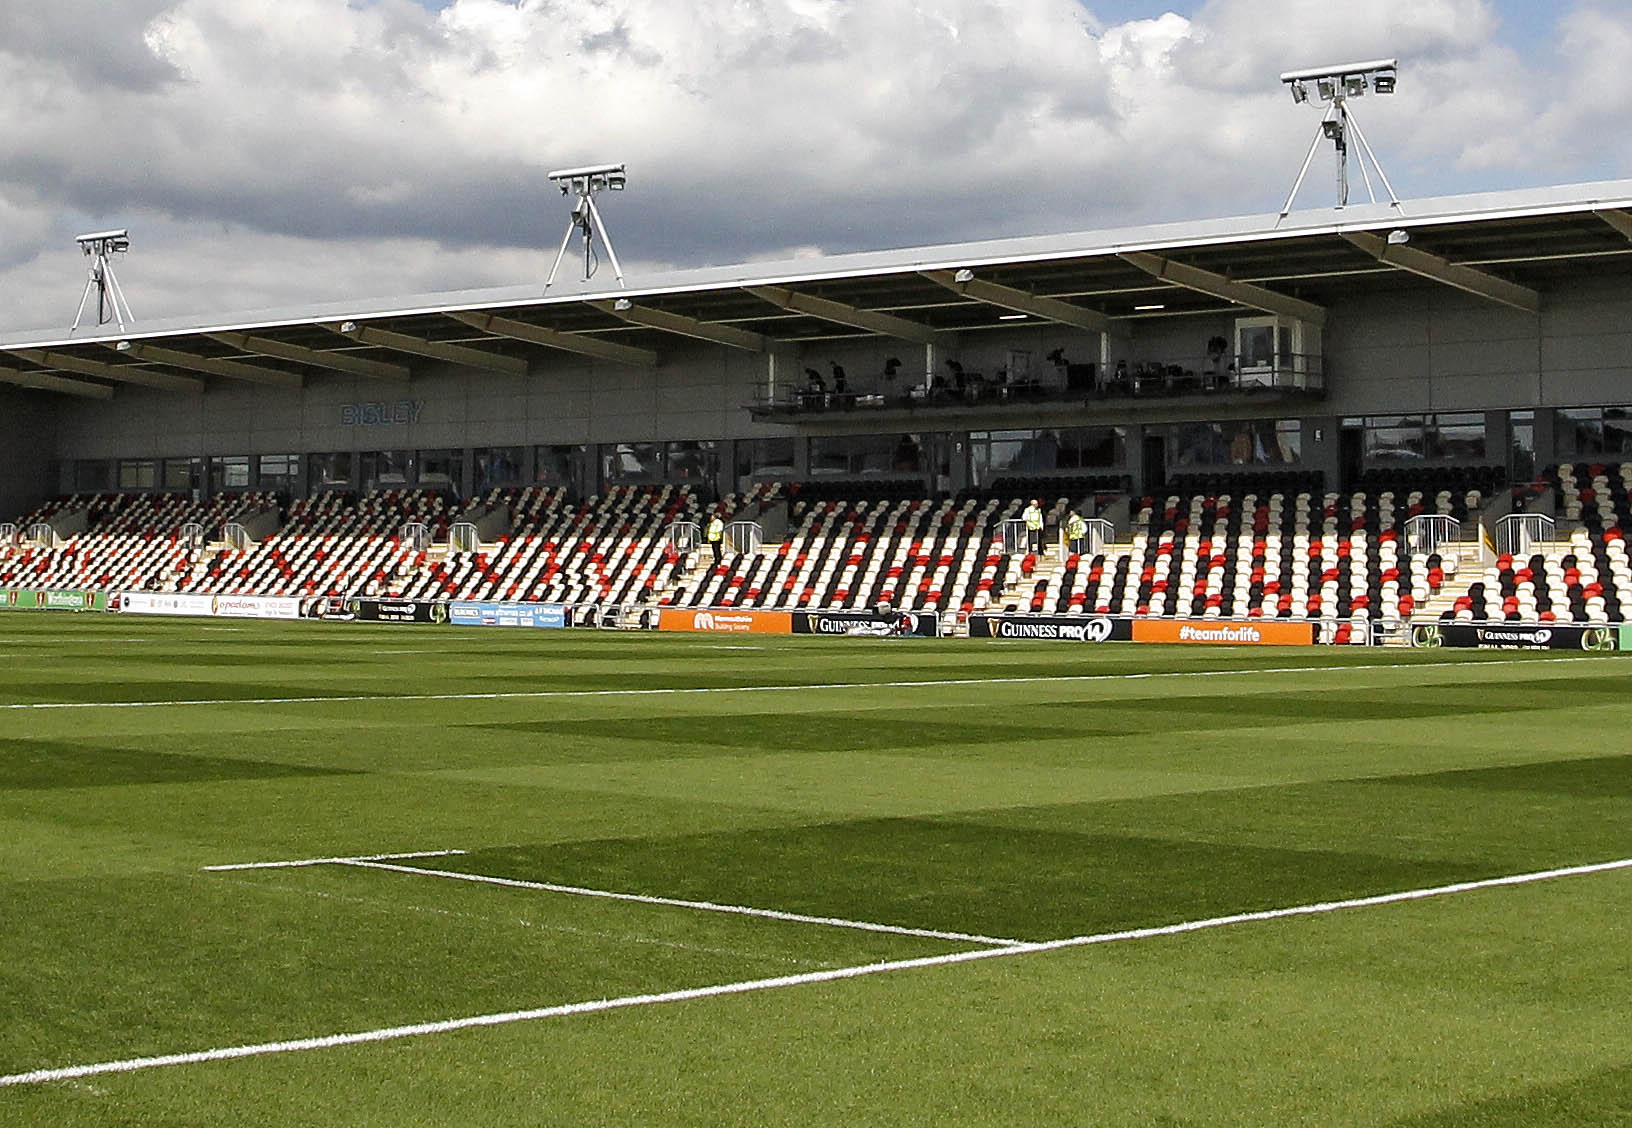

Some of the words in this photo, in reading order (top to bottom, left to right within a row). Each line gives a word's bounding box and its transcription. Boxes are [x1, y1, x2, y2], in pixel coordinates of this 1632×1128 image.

[341, 400, 425, 426] BISLEY
[1001, 621, 1058, 637] GUINNESS
[1179, 625, 1261, 642] #teamforlife
